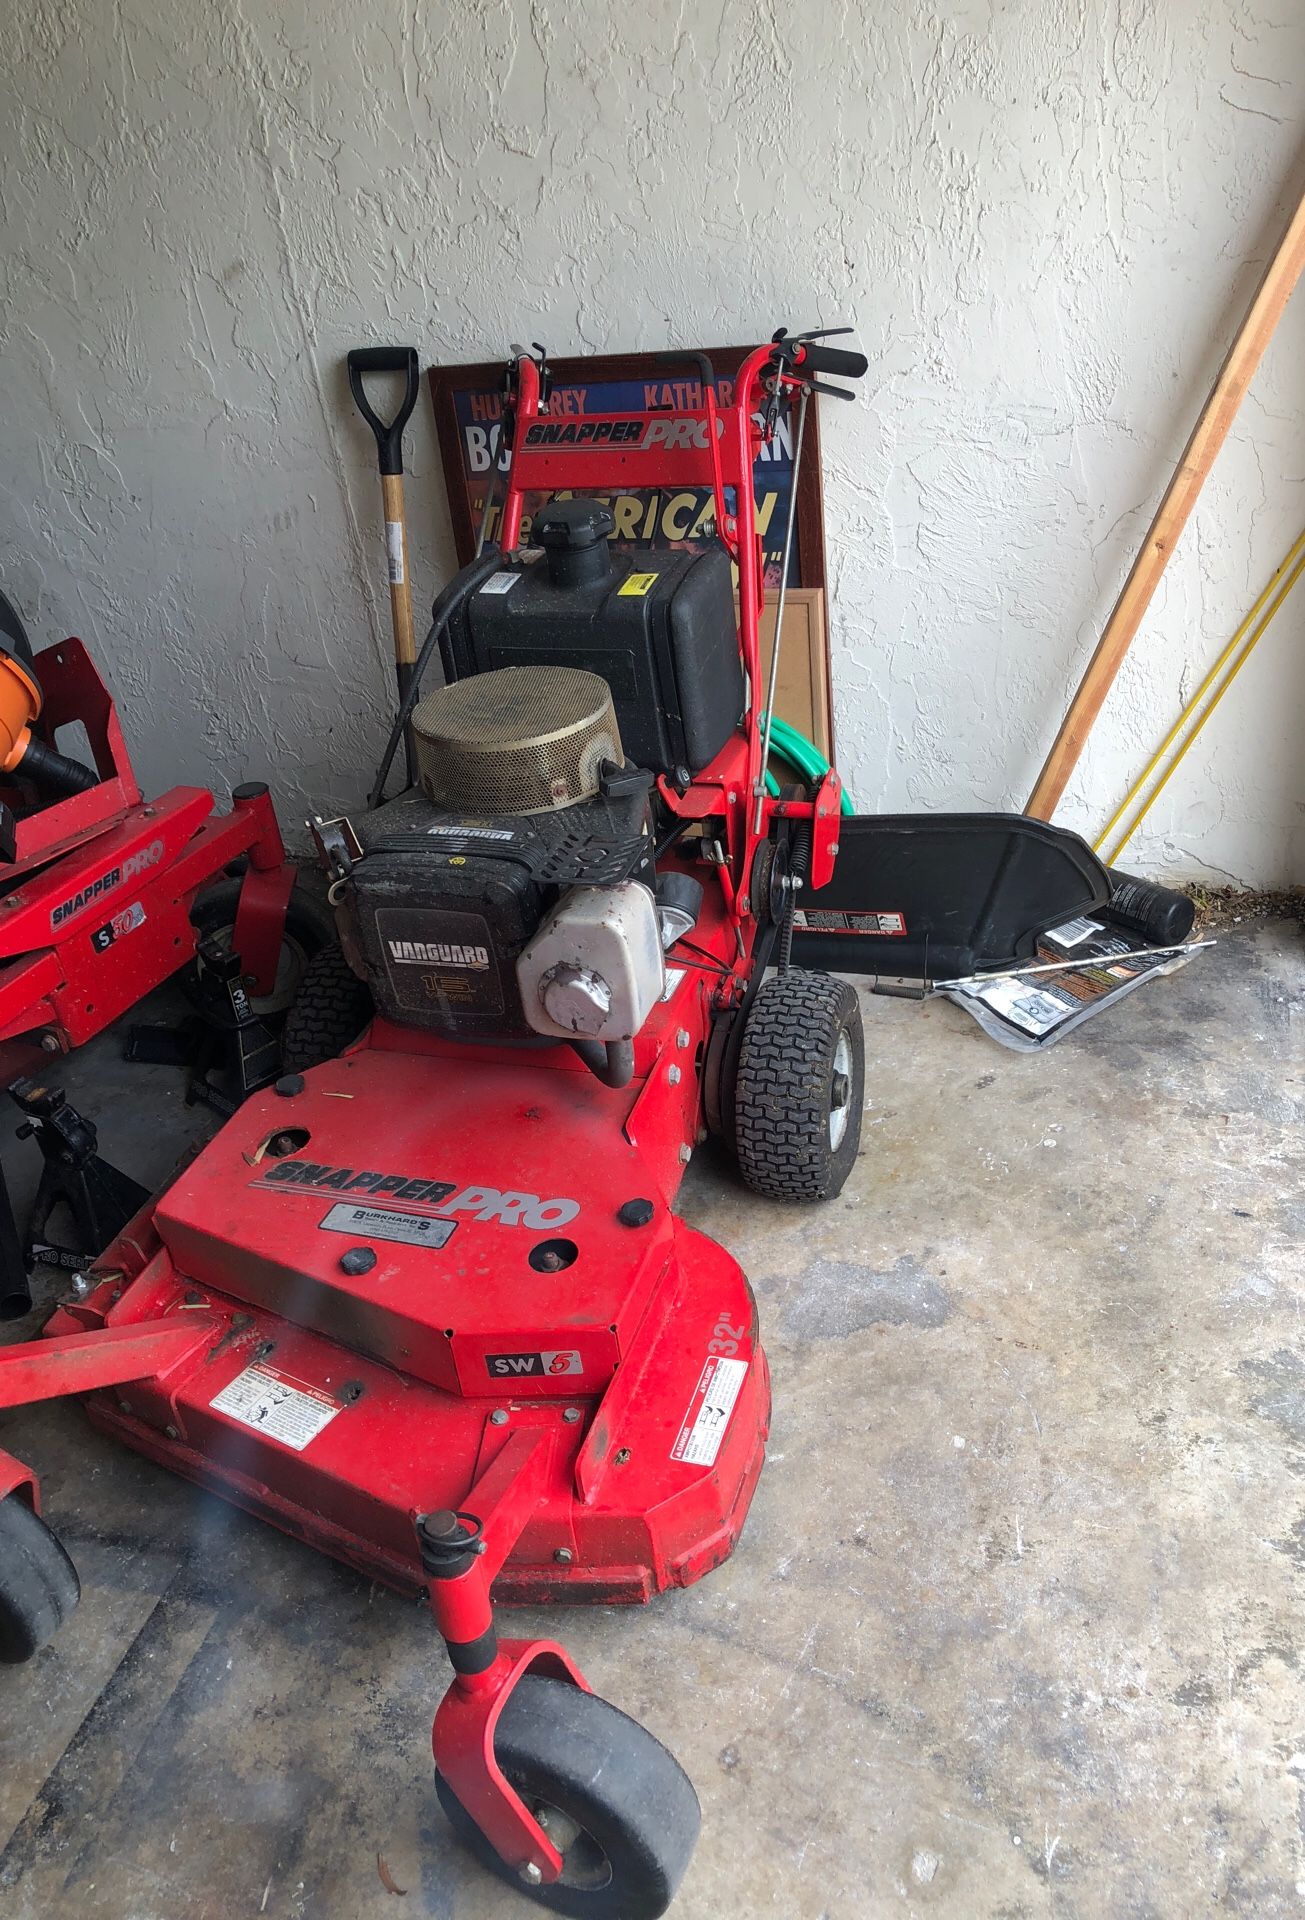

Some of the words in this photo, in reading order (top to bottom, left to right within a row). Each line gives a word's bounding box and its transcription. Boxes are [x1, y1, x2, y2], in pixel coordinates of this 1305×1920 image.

[525, 420, 643, 445] SNAPPER
[641, 417, 724, 450] PRO
[52, 866, 121, 925] SNAPPER
[122, 840, 164, 882] PRO
[387, 940, 489, 965] VANGUARD
[233, 989, 246, 1004] 3
[235, 1000, 249, 1011] TON
[264, 1161, 457, 1204] SNAPPER
[438, 1185, 581, 1231] PRO
[708, 1311, 745, 1356] 32"
[494, 1357, 535, 1374] SW
[548, 1352, 575, 1374] 5
[703, 1365, 714, 1390] PELIGRO
[676, 1427, 691, 1451] DANGER
